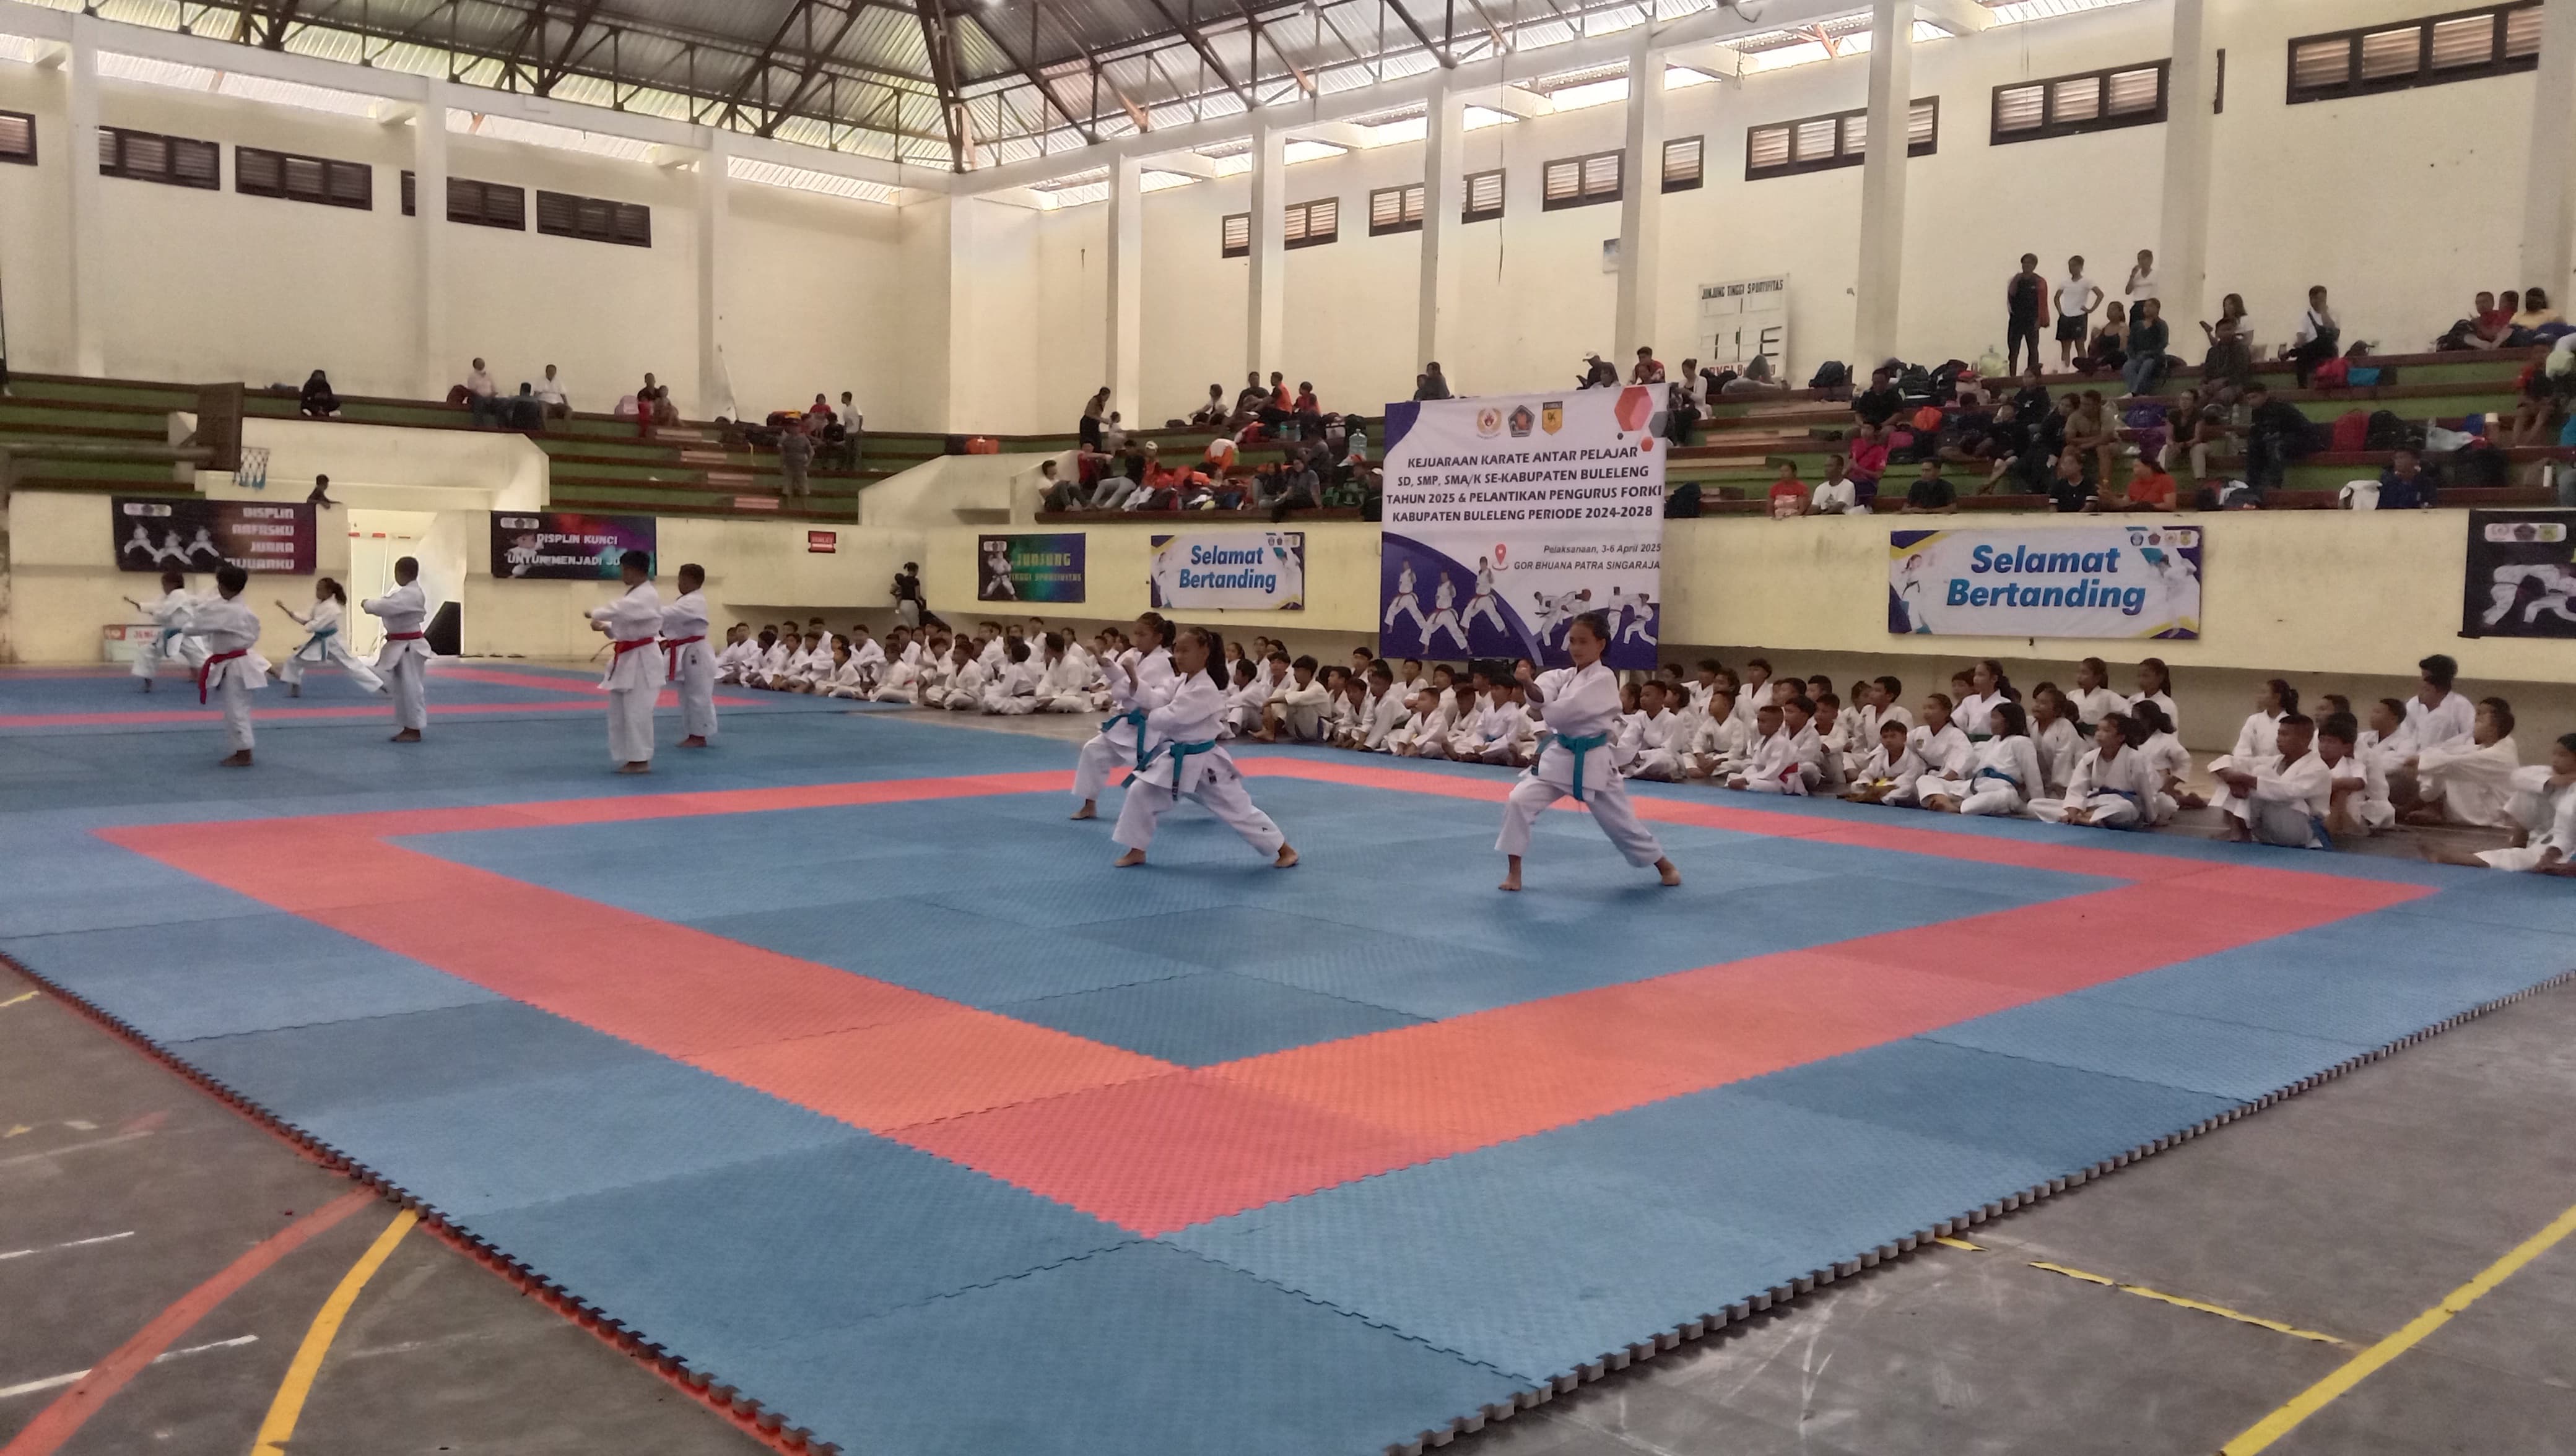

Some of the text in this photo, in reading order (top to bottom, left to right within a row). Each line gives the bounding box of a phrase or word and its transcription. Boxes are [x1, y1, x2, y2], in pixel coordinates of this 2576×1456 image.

[1408, 447, 1638, 468] KEJUARAAN KARATE ANTAR PELAJAR
[1398, 466, 1649, 487] SD, SMP, SMA/K SE-KABUPATEN BULELENG
[1386, 485, 1662, 504] TAHUN 2025 & PELANTIKAN PENGURUS FORKI
[1393, 506, 1653, 522] KABUPATEN BULELENG PERIODE 2024-2028
[537, 534, 618, 545] DISPLIN KUNCI
[1544, 544, 1661, 554] Pelaksanaan, 3-6 April 2025
[551, 555, 603, 565] MENJADI
[1191, 545, 1264, 565] Selamat
[1970, 545, 2121, 573] Selamat
[1514, 560, 1660, 570] GOR BHUANA PATRA SINGARAJA
[1179, 568, 1277, 594] Bertanding
[1946, 578, 2146, 615] Bertanding
